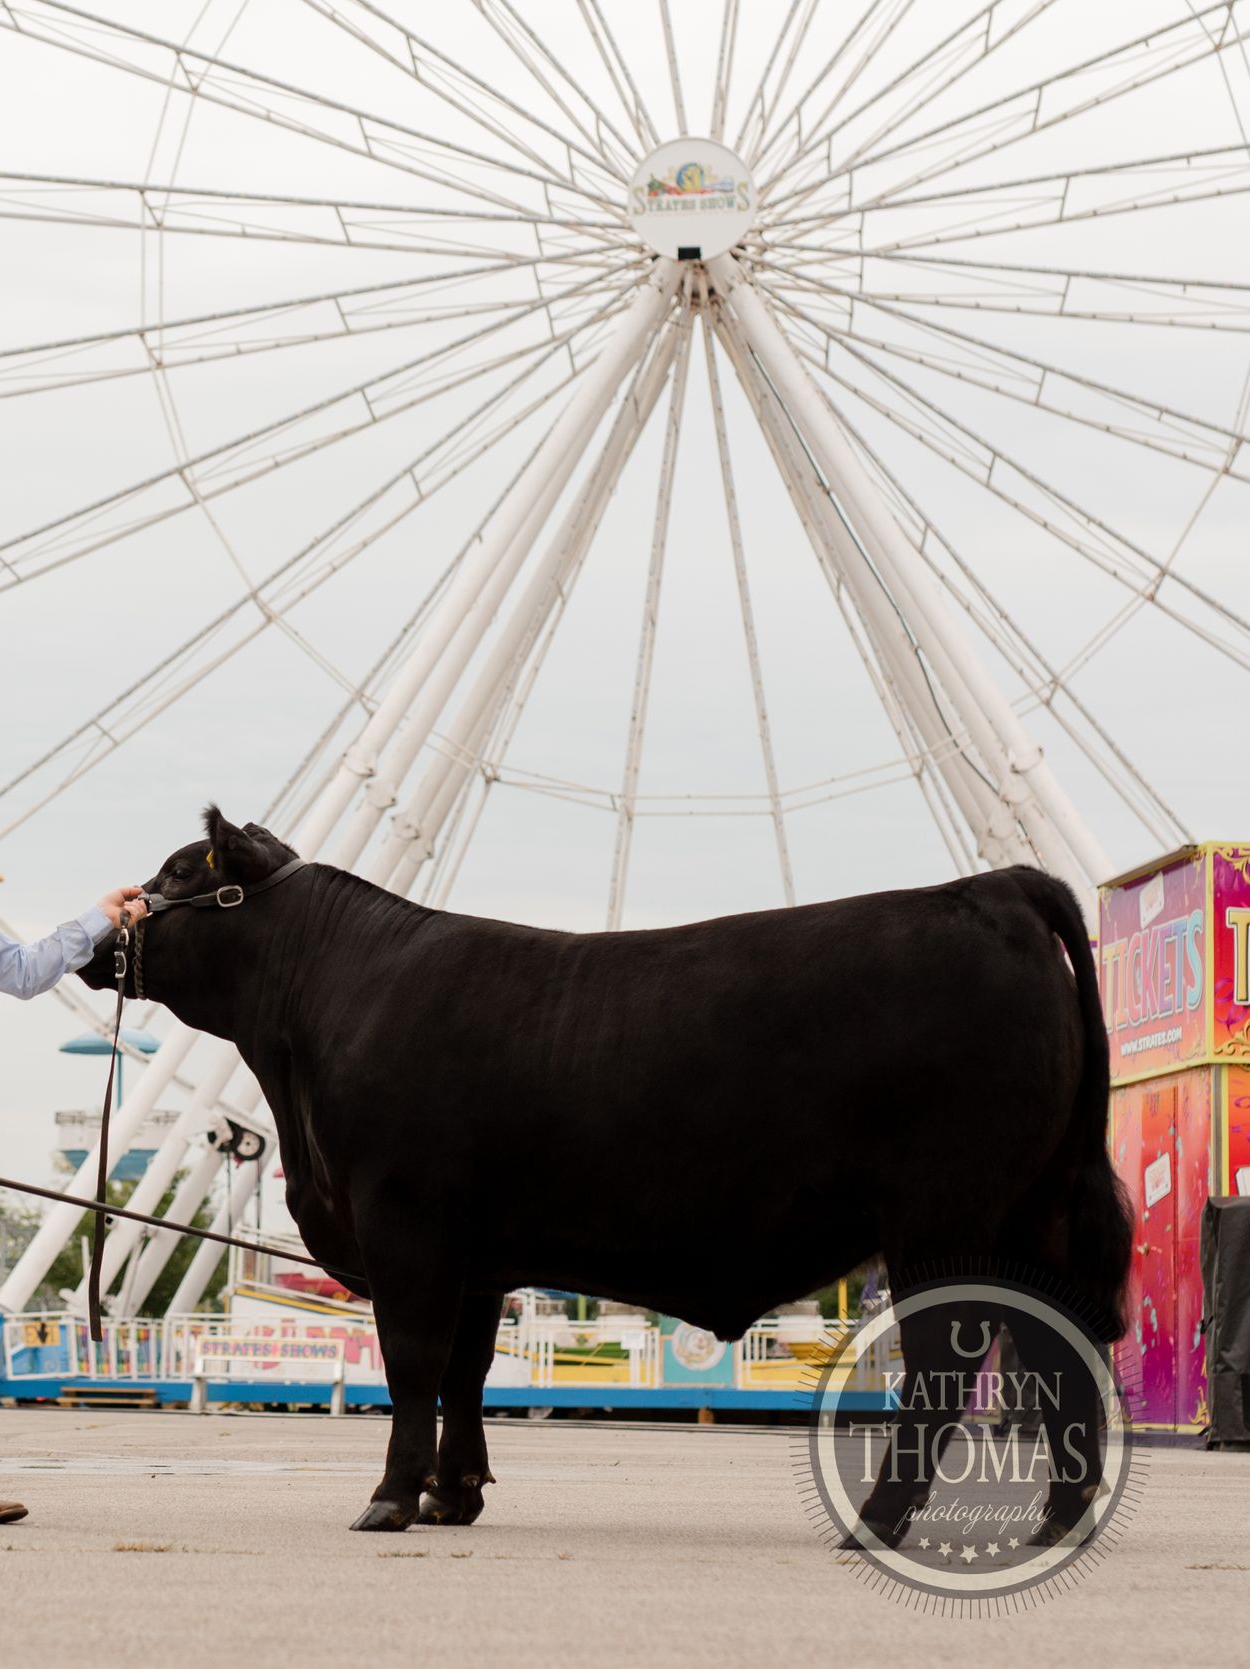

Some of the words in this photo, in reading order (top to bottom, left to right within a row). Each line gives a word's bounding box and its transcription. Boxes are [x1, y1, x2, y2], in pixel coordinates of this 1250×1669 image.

[700, 181, 750, 212] SHOWS
[1103, 909, 1204, 1034] TICKETS
[1121, 1027, 1182, 1057] WWW.STRATES.COM
[203, 1342, 271, 1358] STRATES
[280, 1343, 338, 1358] SHOWS
